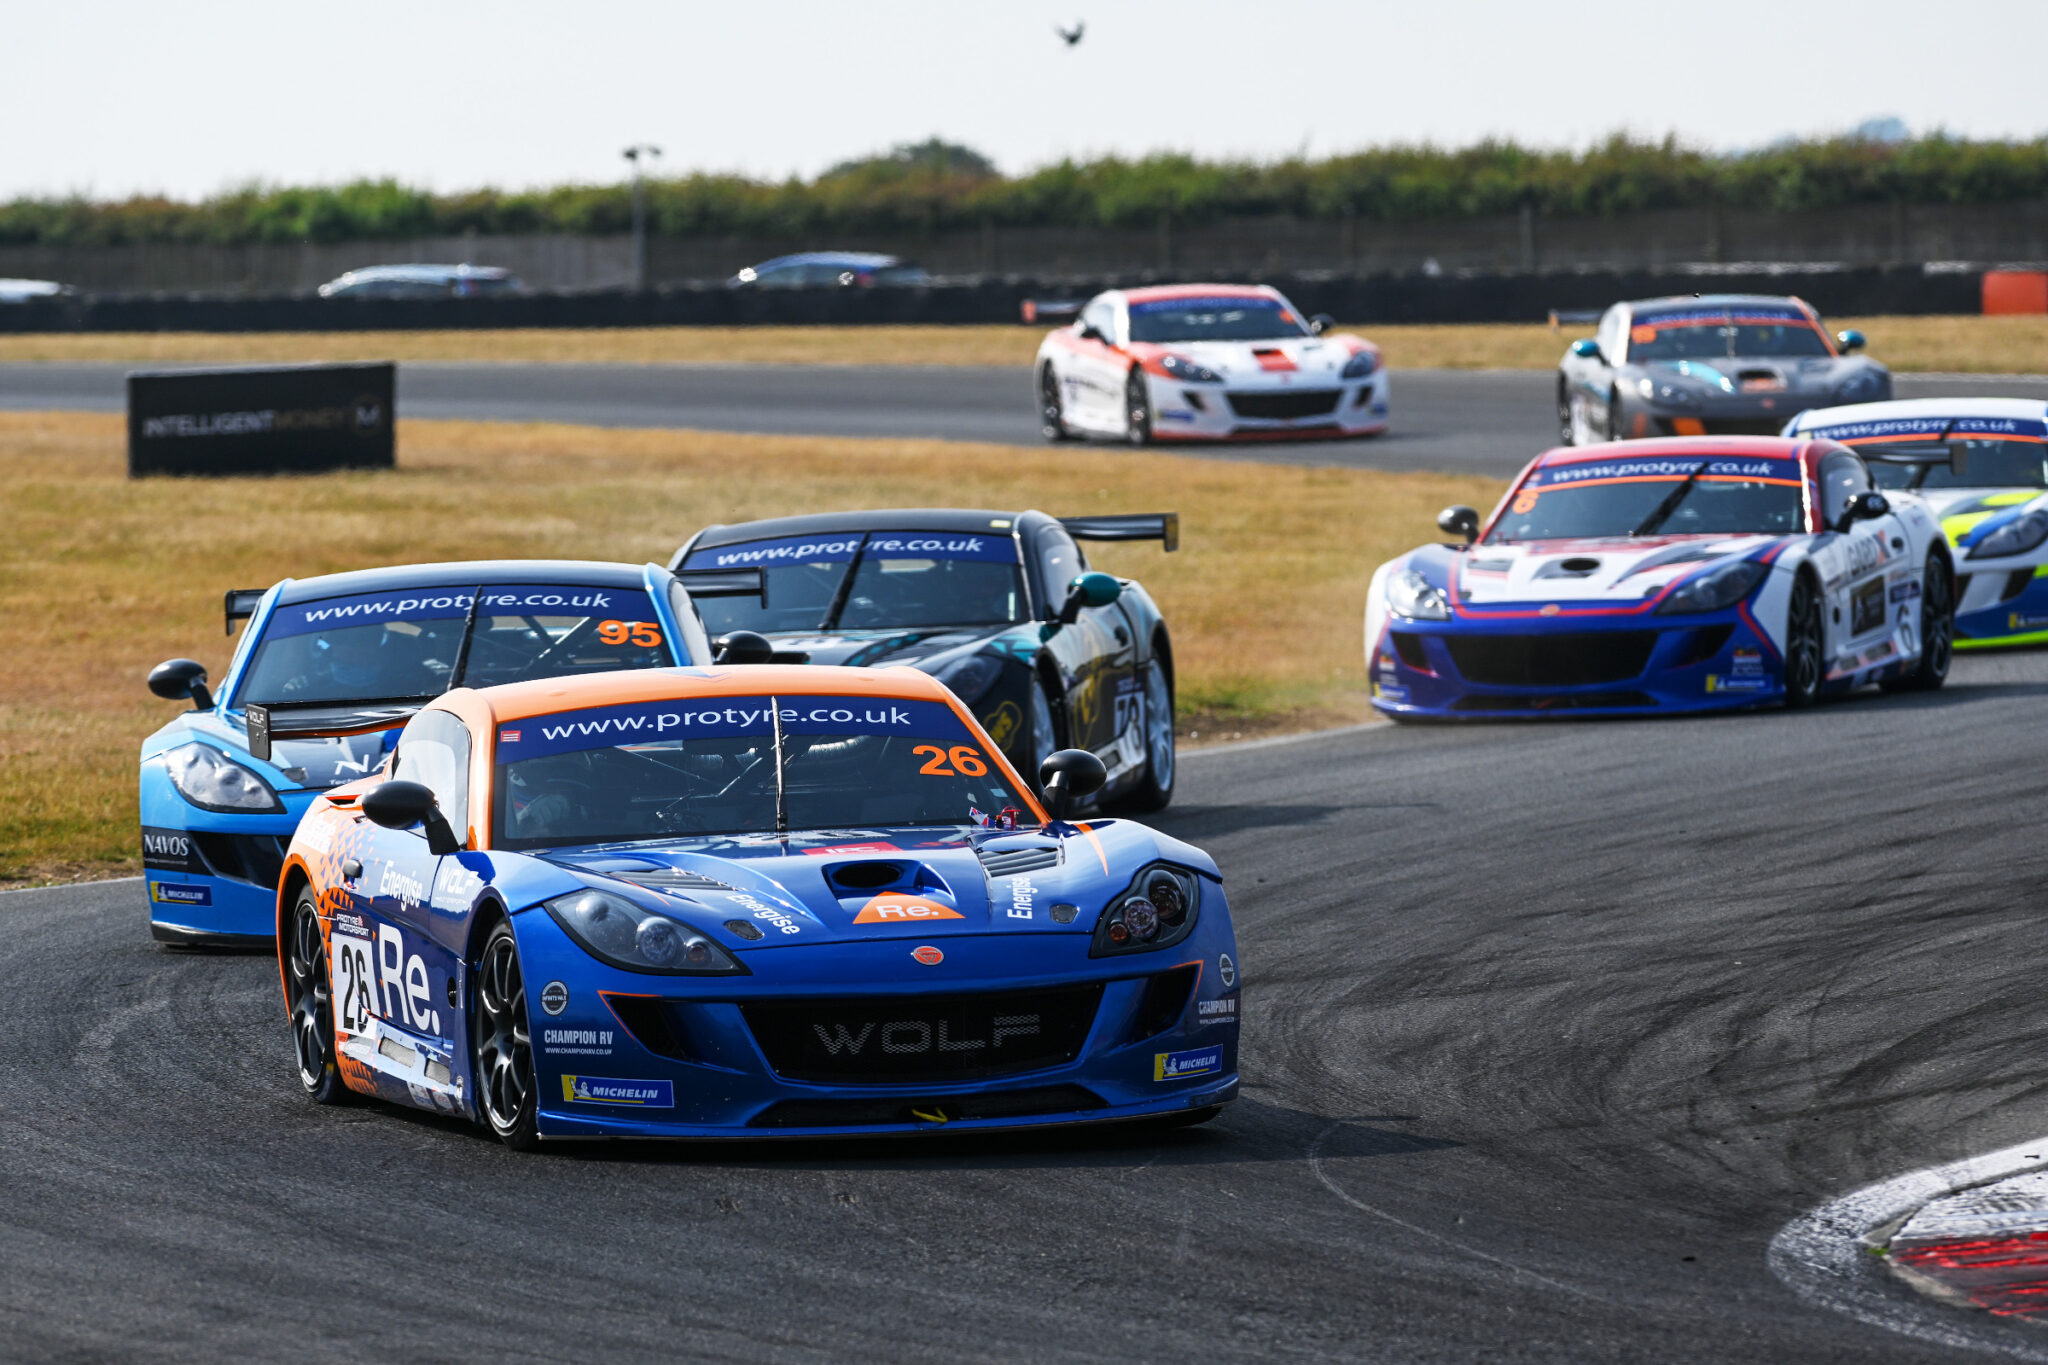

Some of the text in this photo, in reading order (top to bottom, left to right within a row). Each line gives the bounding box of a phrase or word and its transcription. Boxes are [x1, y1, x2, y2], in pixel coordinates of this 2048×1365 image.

[1813, 419, 2017, 439] www.protyreco.uk
[1553, 461, 1772, 482] www.protyreco.uk
[717, 538, 984, 566] www.protre.co.uk
[305, 592, 612, 623] www.protyre.co.uk
[598, 619, 663, 648] 95
[541, 706, 912, 741] www.protyre.co.uk
[912, 744, 988, 777] 26
[144, 834, 189, 856] NAVOS
[379, 860, 423, 911] Energise
[438, 867, 479, 895] WOLF
[875, 904, 939, 919] Re.
[1006, 877, 1038, 919] Energise
[726, 894, 801, 936] Energise
[342, 944, 372, 1034] 26
[379, 923, 440, 1036] Re.
[544, 1030, 613, 1045] CHAMPION RV
[813, 1014, 1040, 1056] WOLF
[1179, 1055, 1217, 1070] MICHELIN
[592, 1086, 658, 1099] MICHELIN
